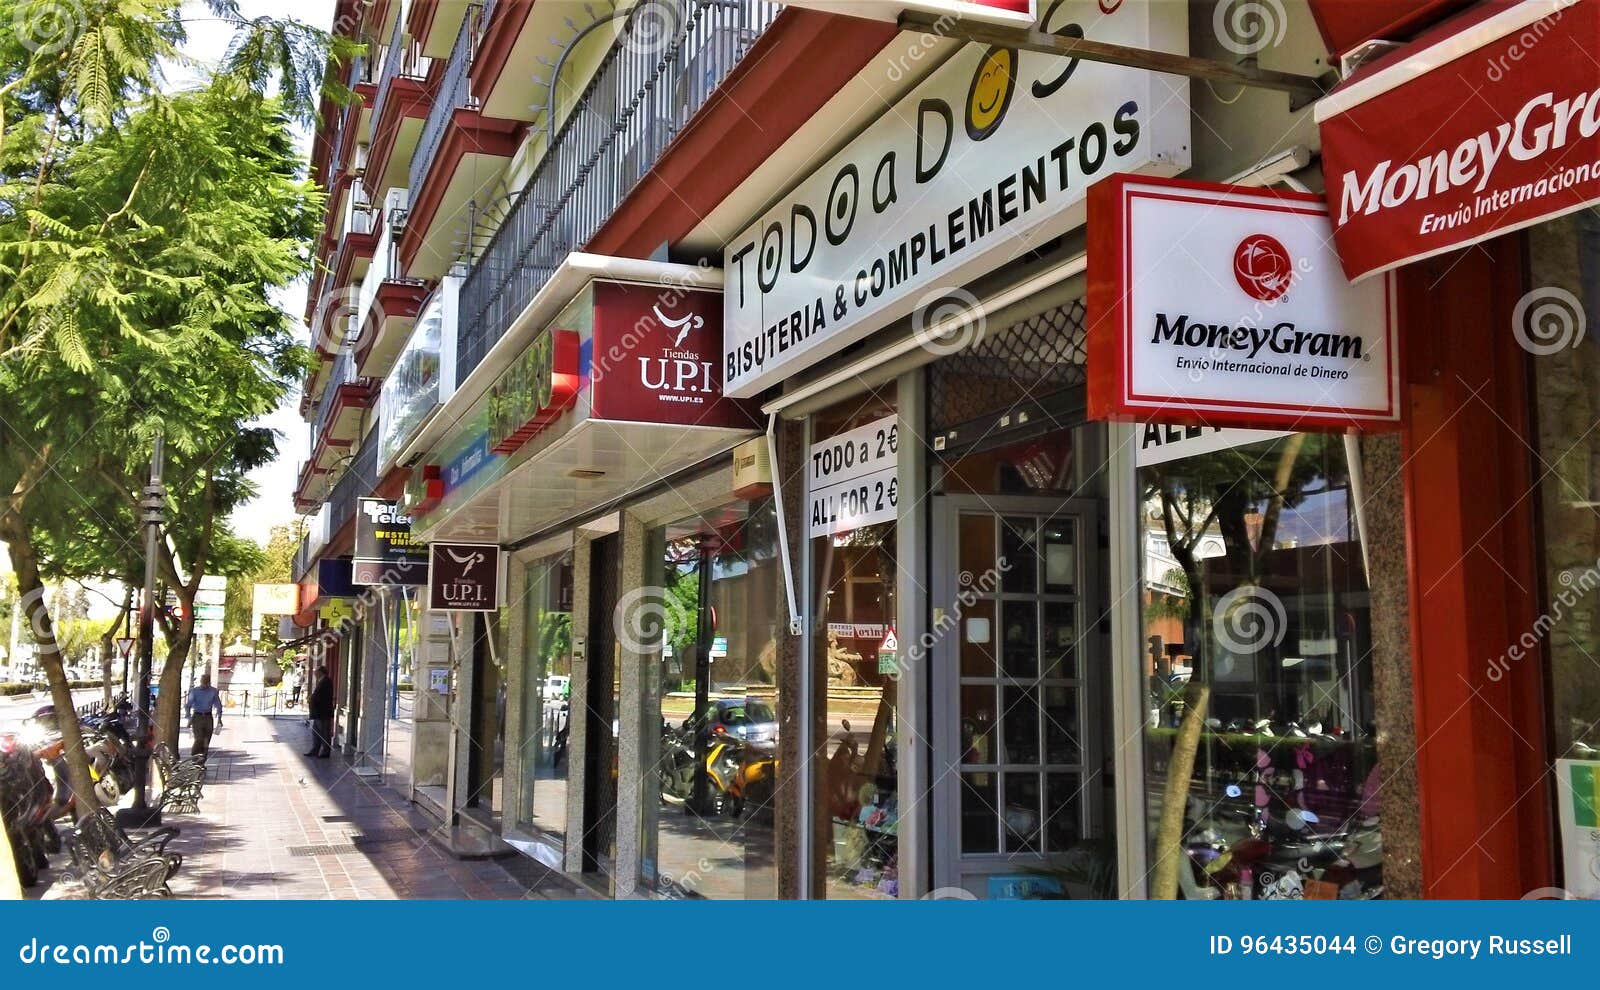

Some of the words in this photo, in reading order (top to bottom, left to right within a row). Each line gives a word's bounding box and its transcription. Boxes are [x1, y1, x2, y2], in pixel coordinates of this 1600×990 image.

[727, 297, 826, 383] BISUTERIA
[833, 284, 848, 322] &
[854, 100, 1141, 308] COMPLEMENTOS
[662, 347, 699, 361] Tiendas
[1151, 313, 1362, 359] MoneyGram
[1211, 359, 1291, 377] Internacional
[1293, 363, 1308, 377] de
[1310, 365, 1349, 380] Dinero
[813, 440, 855, 478] TODO
[860, 441, 868, 464] a
[812, 495, 837, 527] ALL
[840, 485, 869, 520] FOR
